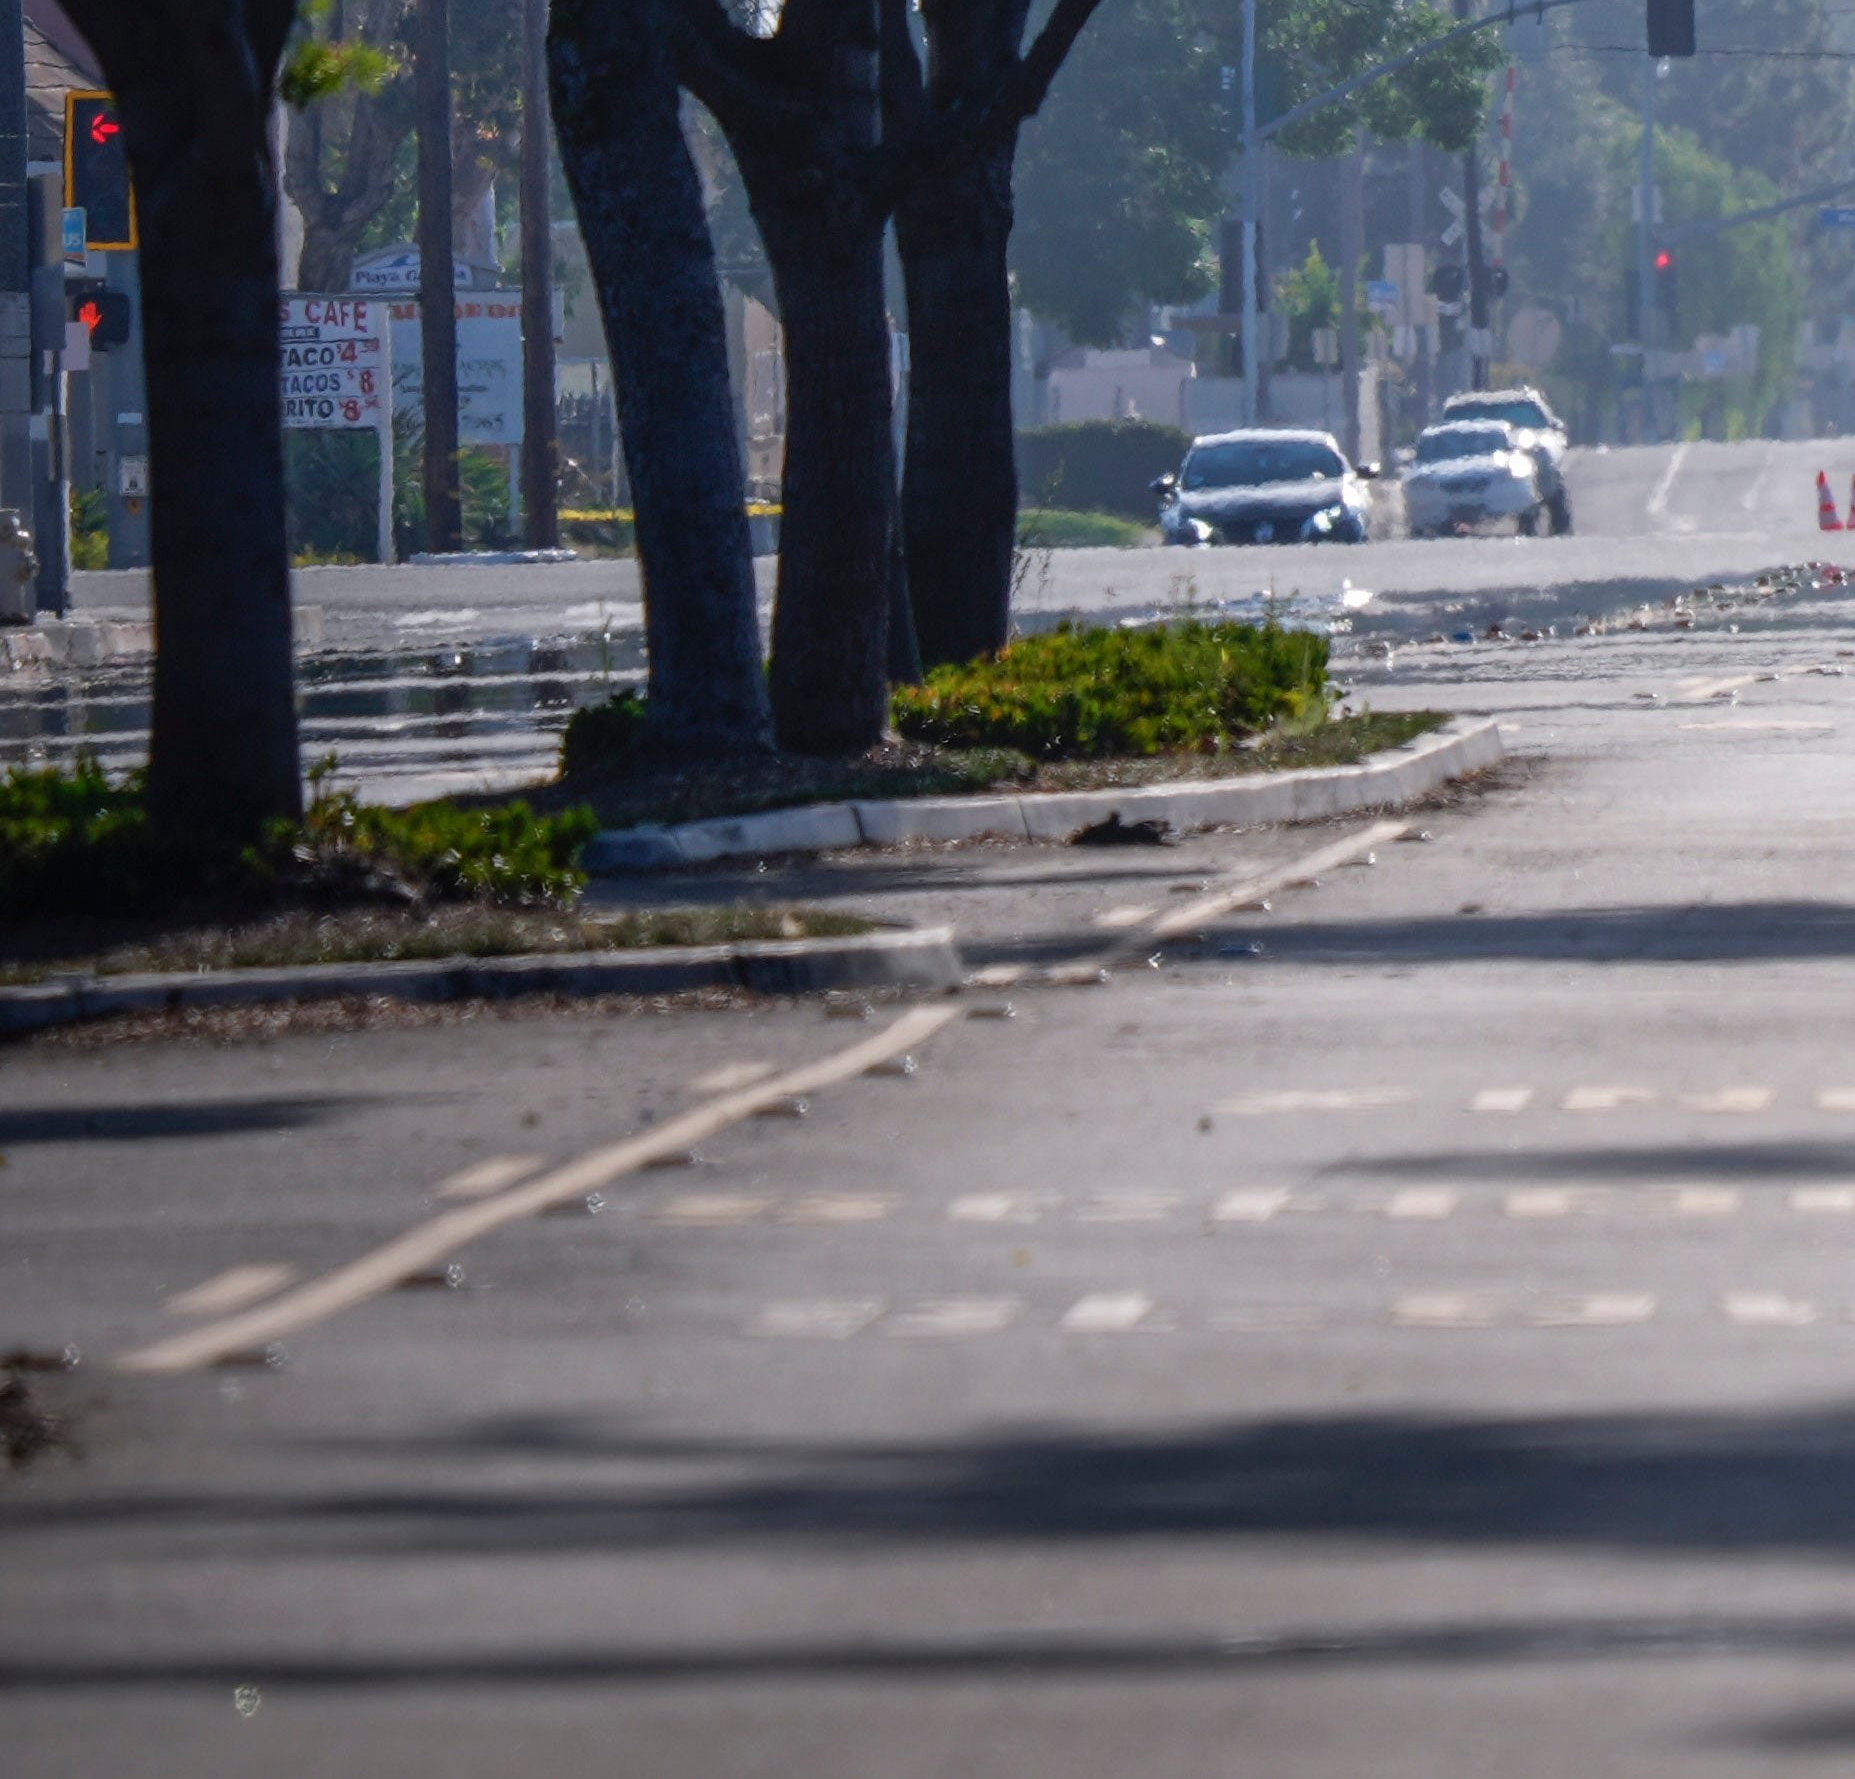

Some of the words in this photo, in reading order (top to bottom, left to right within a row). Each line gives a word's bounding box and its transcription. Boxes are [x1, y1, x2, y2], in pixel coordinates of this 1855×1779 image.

[64, 232, 81, 247] US
[355, 269, 401, 287] Playa
[304, 300, 368, 333] CAFE
[281, 373, 341, 394] TACOS
[284, 398, 334, 419] RITO
